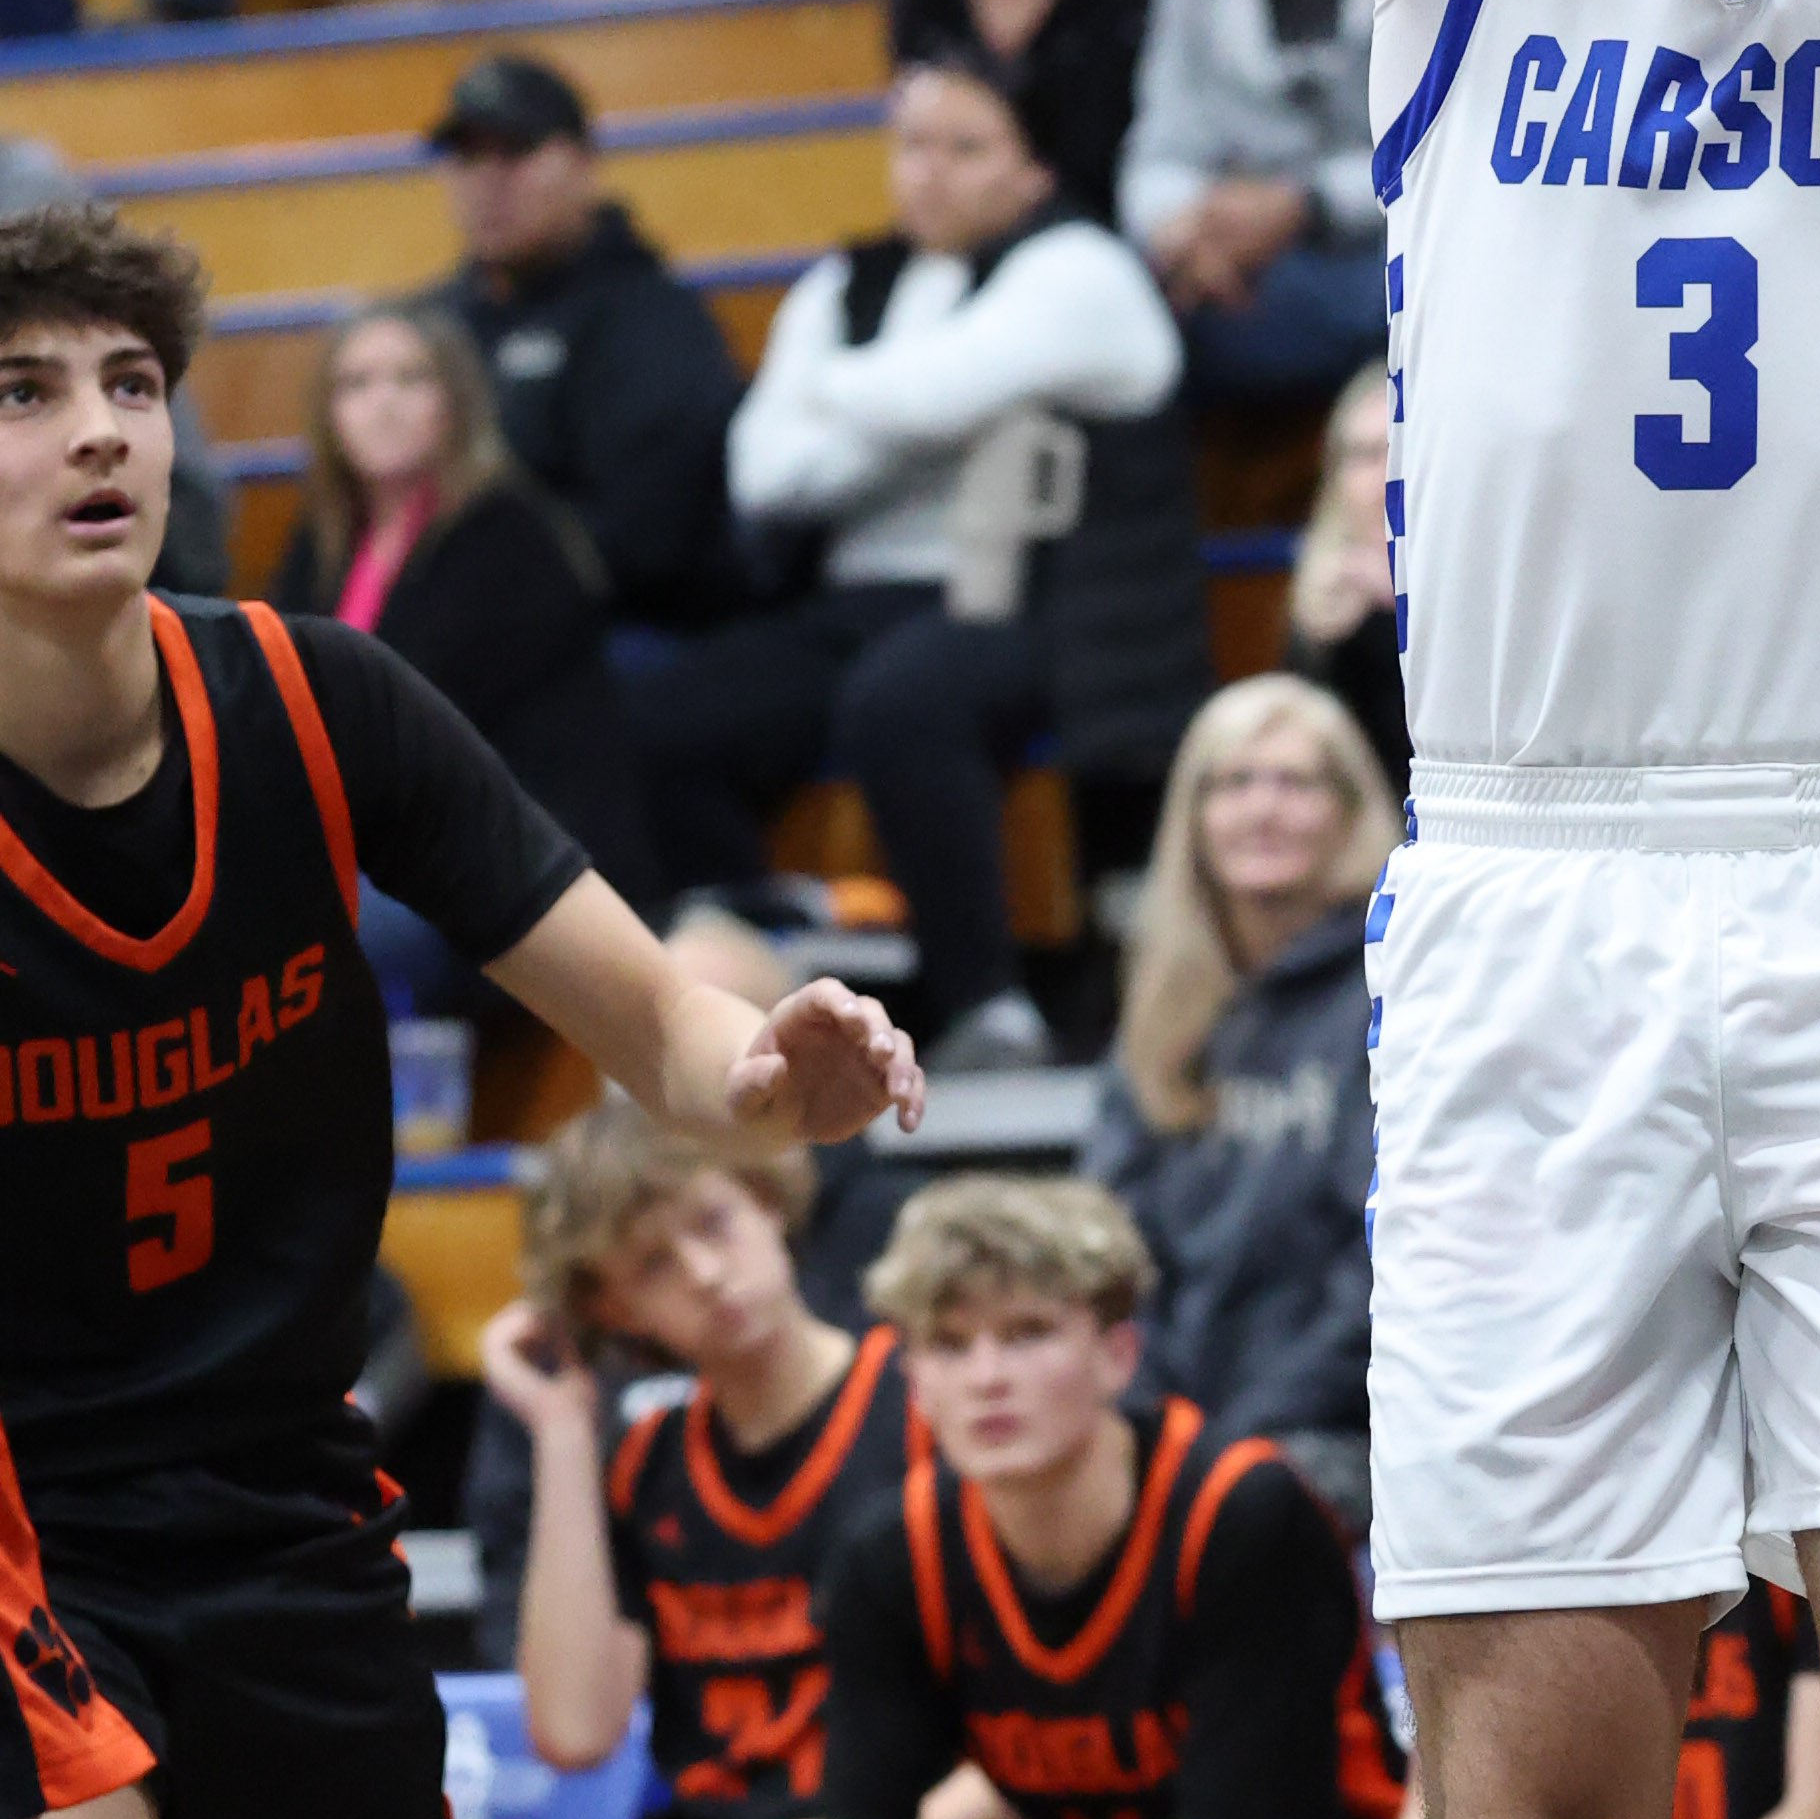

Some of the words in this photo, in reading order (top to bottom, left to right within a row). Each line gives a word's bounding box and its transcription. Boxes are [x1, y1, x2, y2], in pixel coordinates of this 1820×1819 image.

[1633, 236, 1760, 491] 3
[0, 943, 325, 1127] OUGLAS
[126, 1117, 214, 1295] 5
